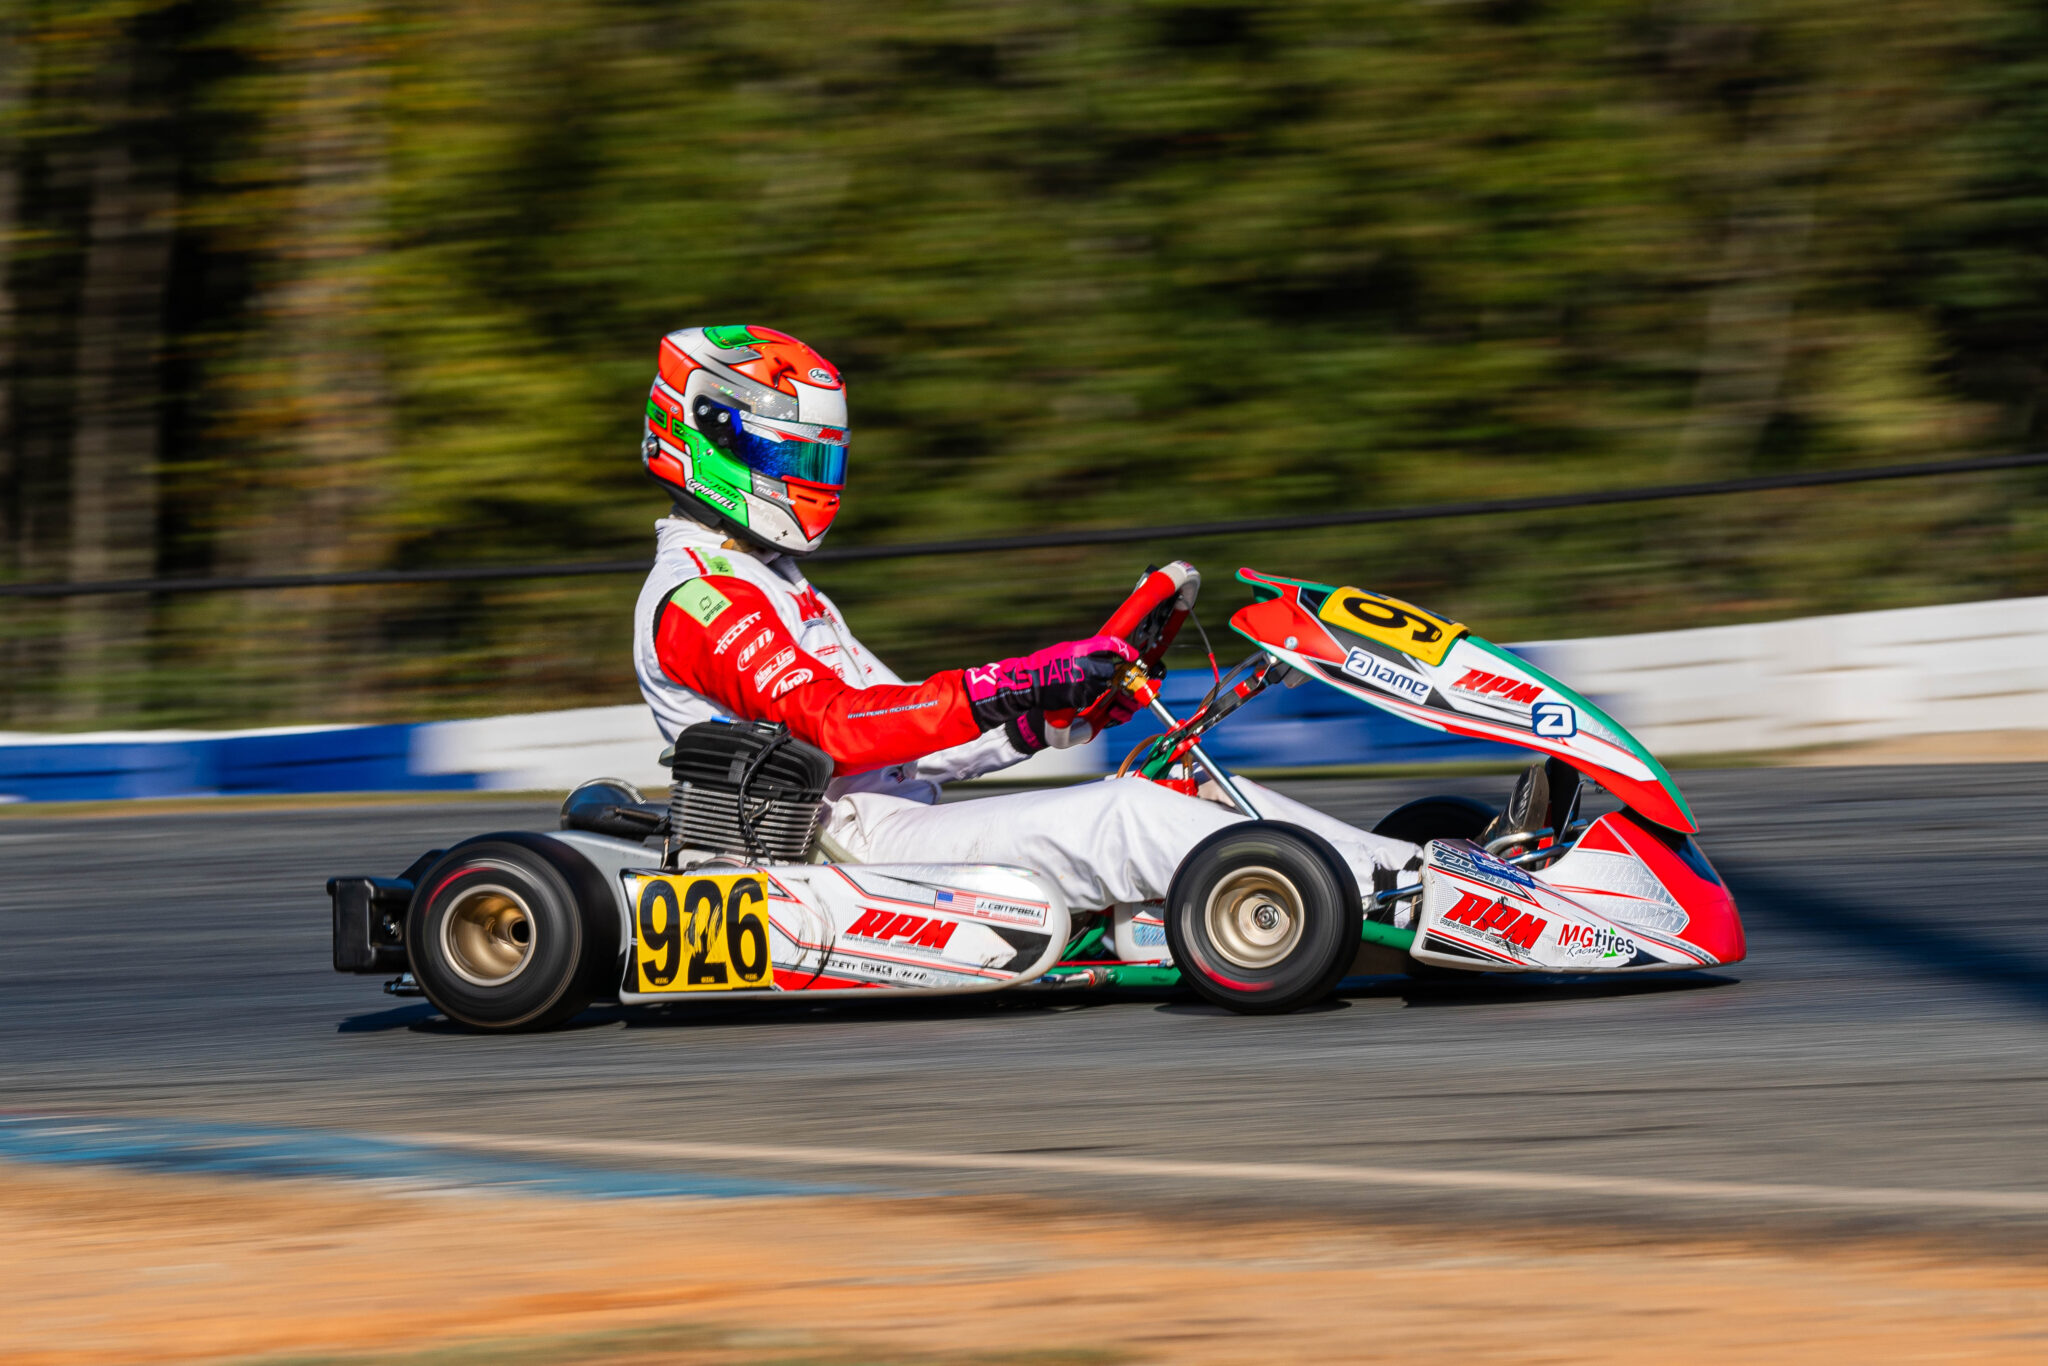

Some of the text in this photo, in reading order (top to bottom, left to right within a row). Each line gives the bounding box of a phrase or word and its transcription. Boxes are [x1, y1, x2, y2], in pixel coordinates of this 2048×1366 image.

[686, 478, 738, 511] CAMPBELL
[1342, 596, 1443, 643] 9
[1451, 667, 1545, 705] RPM
[639, 877, 768, 987] 926
[845, 906, 959, 950] RPM
[1443, 888, 1548, 950] RPM
[1566, 942, 1605, 959] Racing
